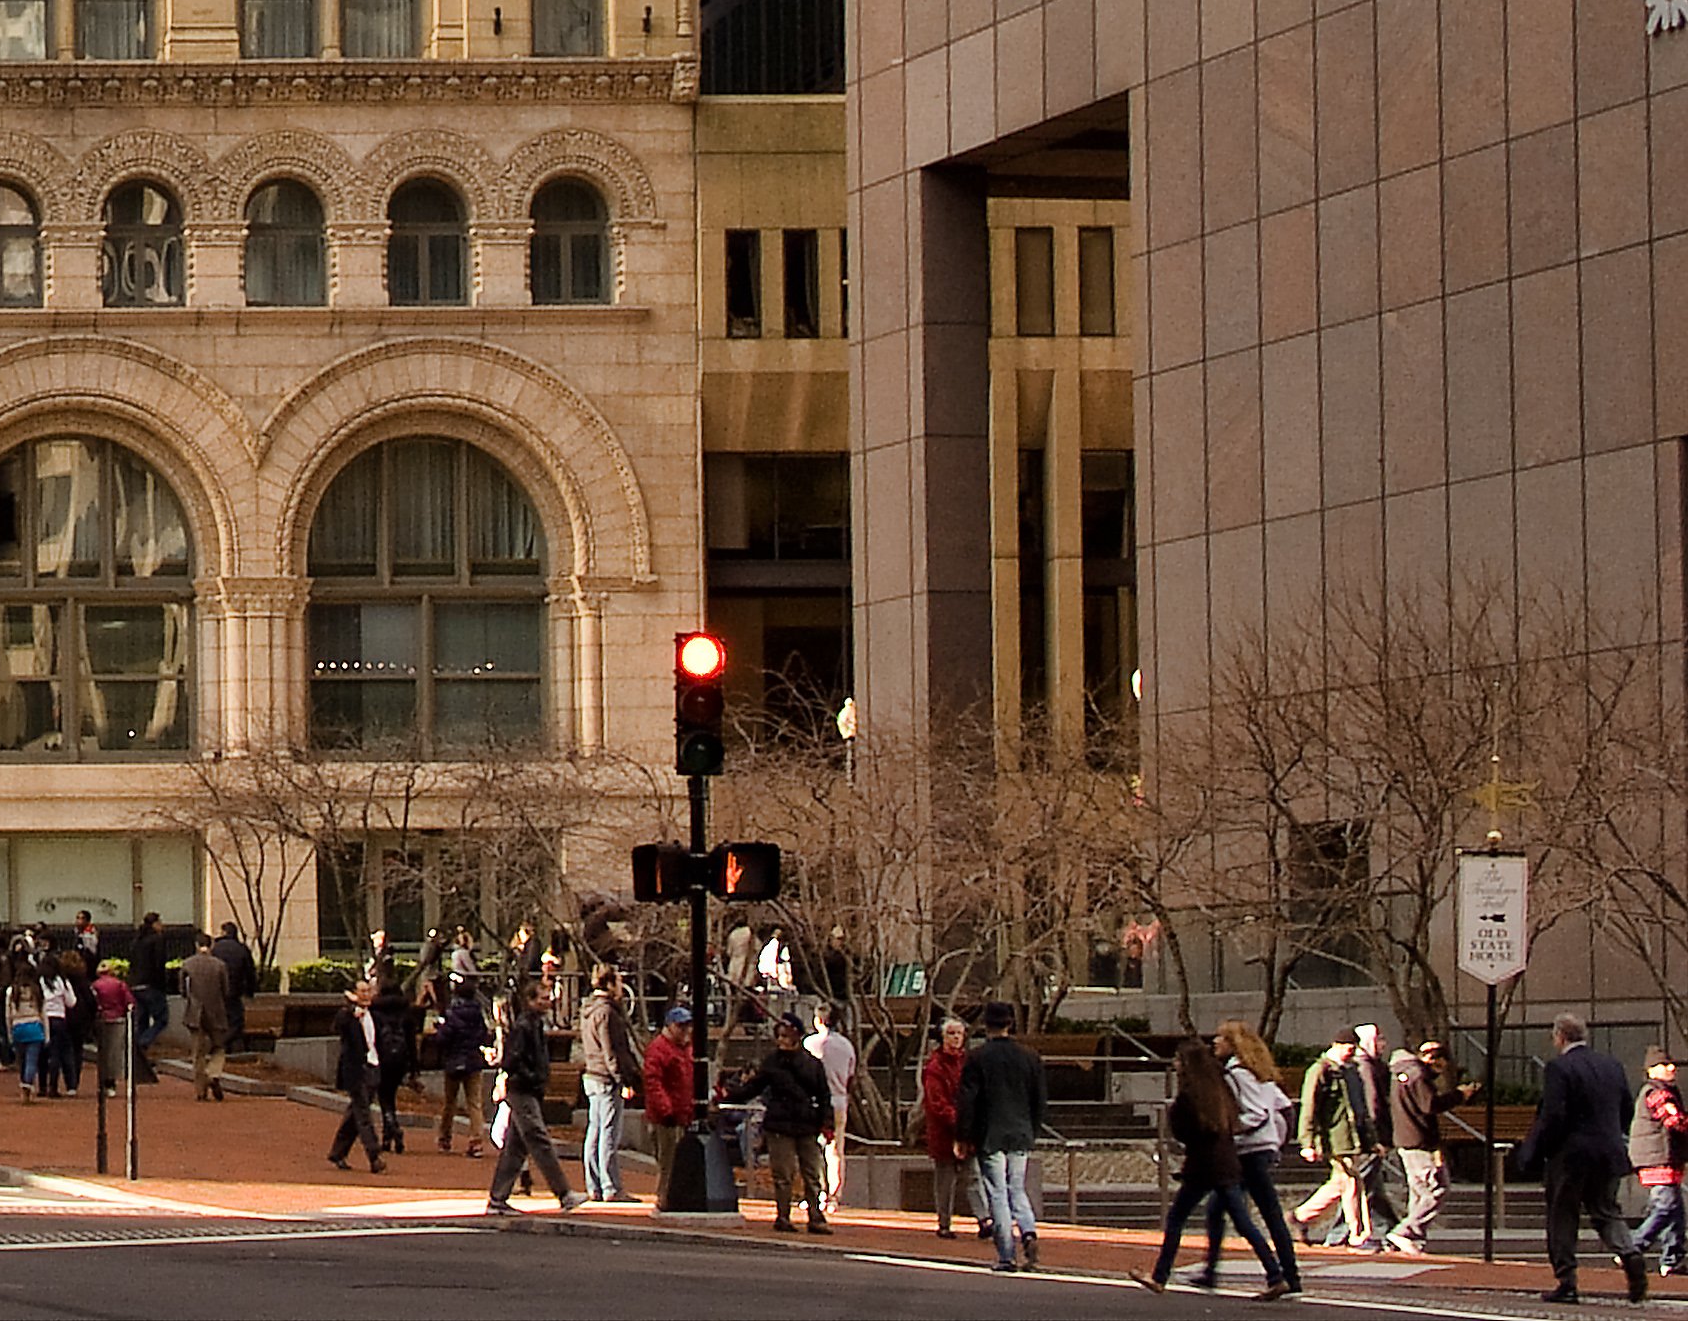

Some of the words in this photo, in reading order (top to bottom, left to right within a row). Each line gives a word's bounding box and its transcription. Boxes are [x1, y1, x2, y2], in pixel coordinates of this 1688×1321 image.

[1478, 929, 1508, 938] OLD
[1470, 941, 1512, 950] STATE
[1469, 951, 1513, 961] HOUSE
